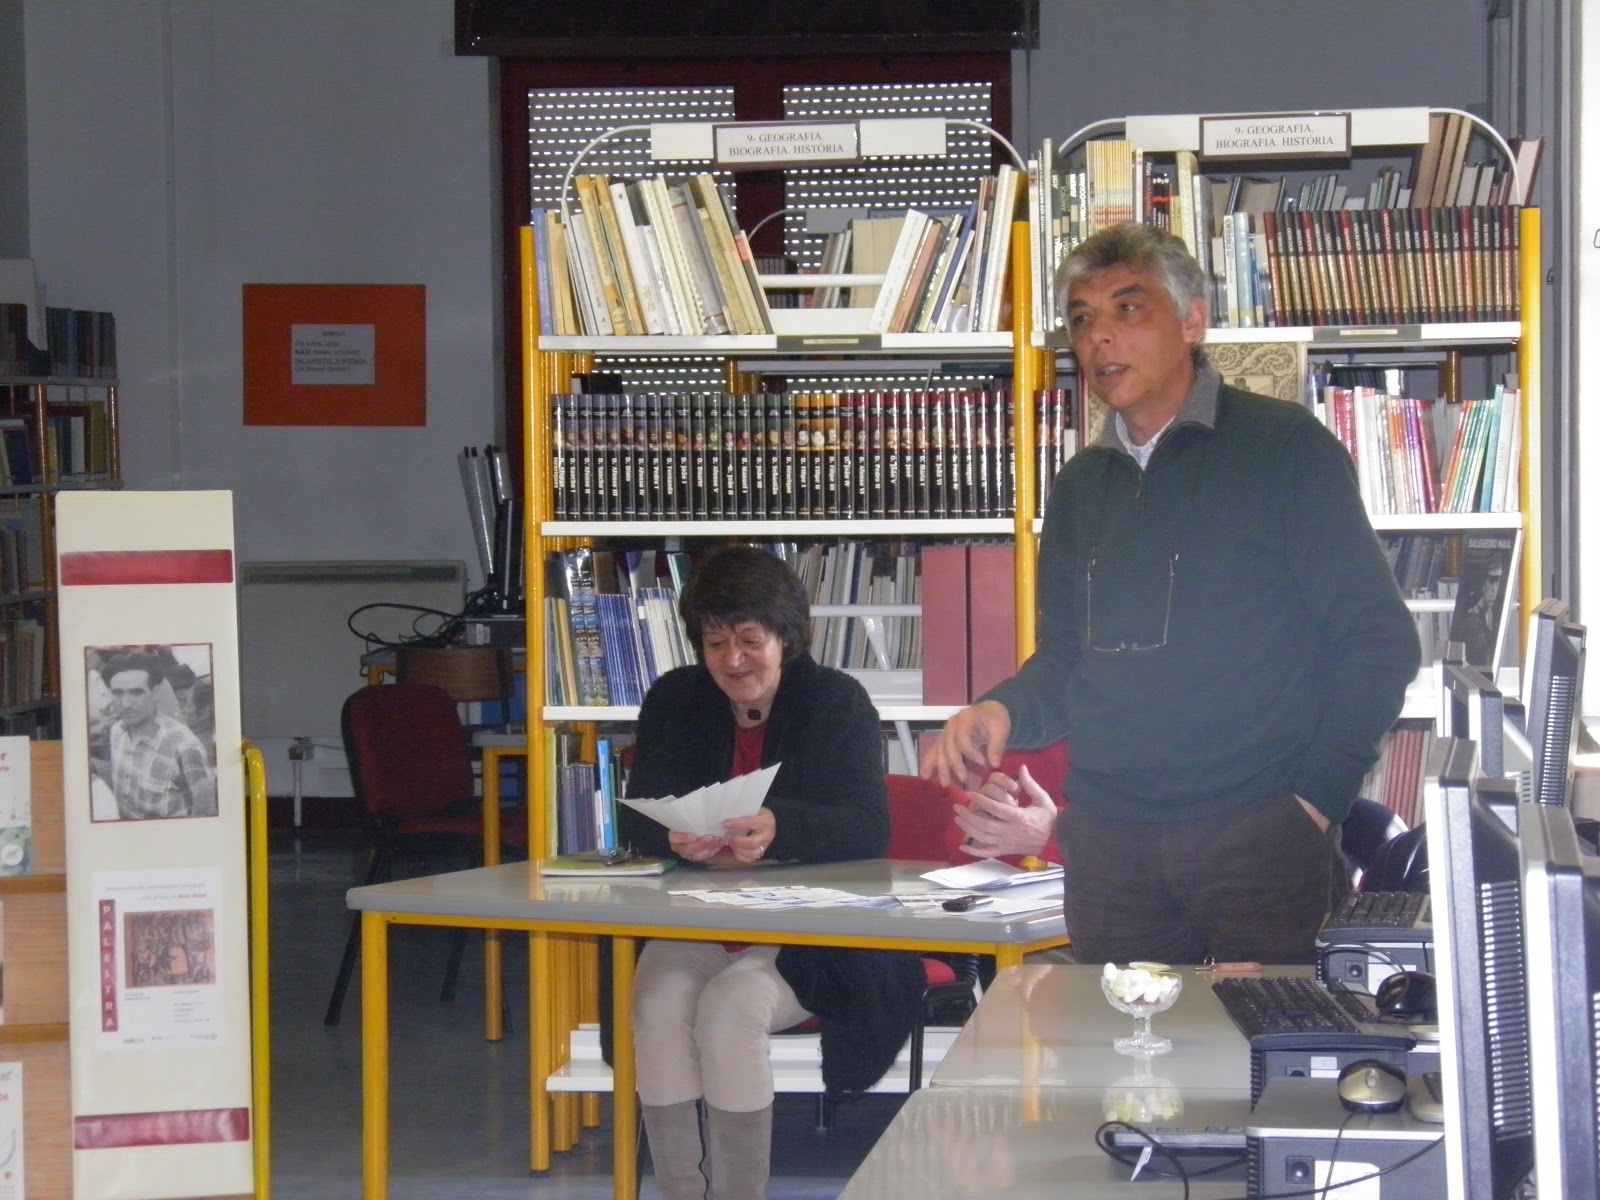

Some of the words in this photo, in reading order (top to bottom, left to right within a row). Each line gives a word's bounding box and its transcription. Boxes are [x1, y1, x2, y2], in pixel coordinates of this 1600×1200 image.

[1247, 124, 1314, 134] GEOGRAFIA.
[758, 132, 824, 142] GEOGRAFIA.
[1216, 138, 1278, 148] BIOGRAFIA.
[1282, 134, 1334, 146] HISTÓRIA
[729, 146, 790, 156] BIOGRAFIA.
[794, 142, 844, 154] HISTÓRIA
[103, 905, 114, 1026] PALESTRA
